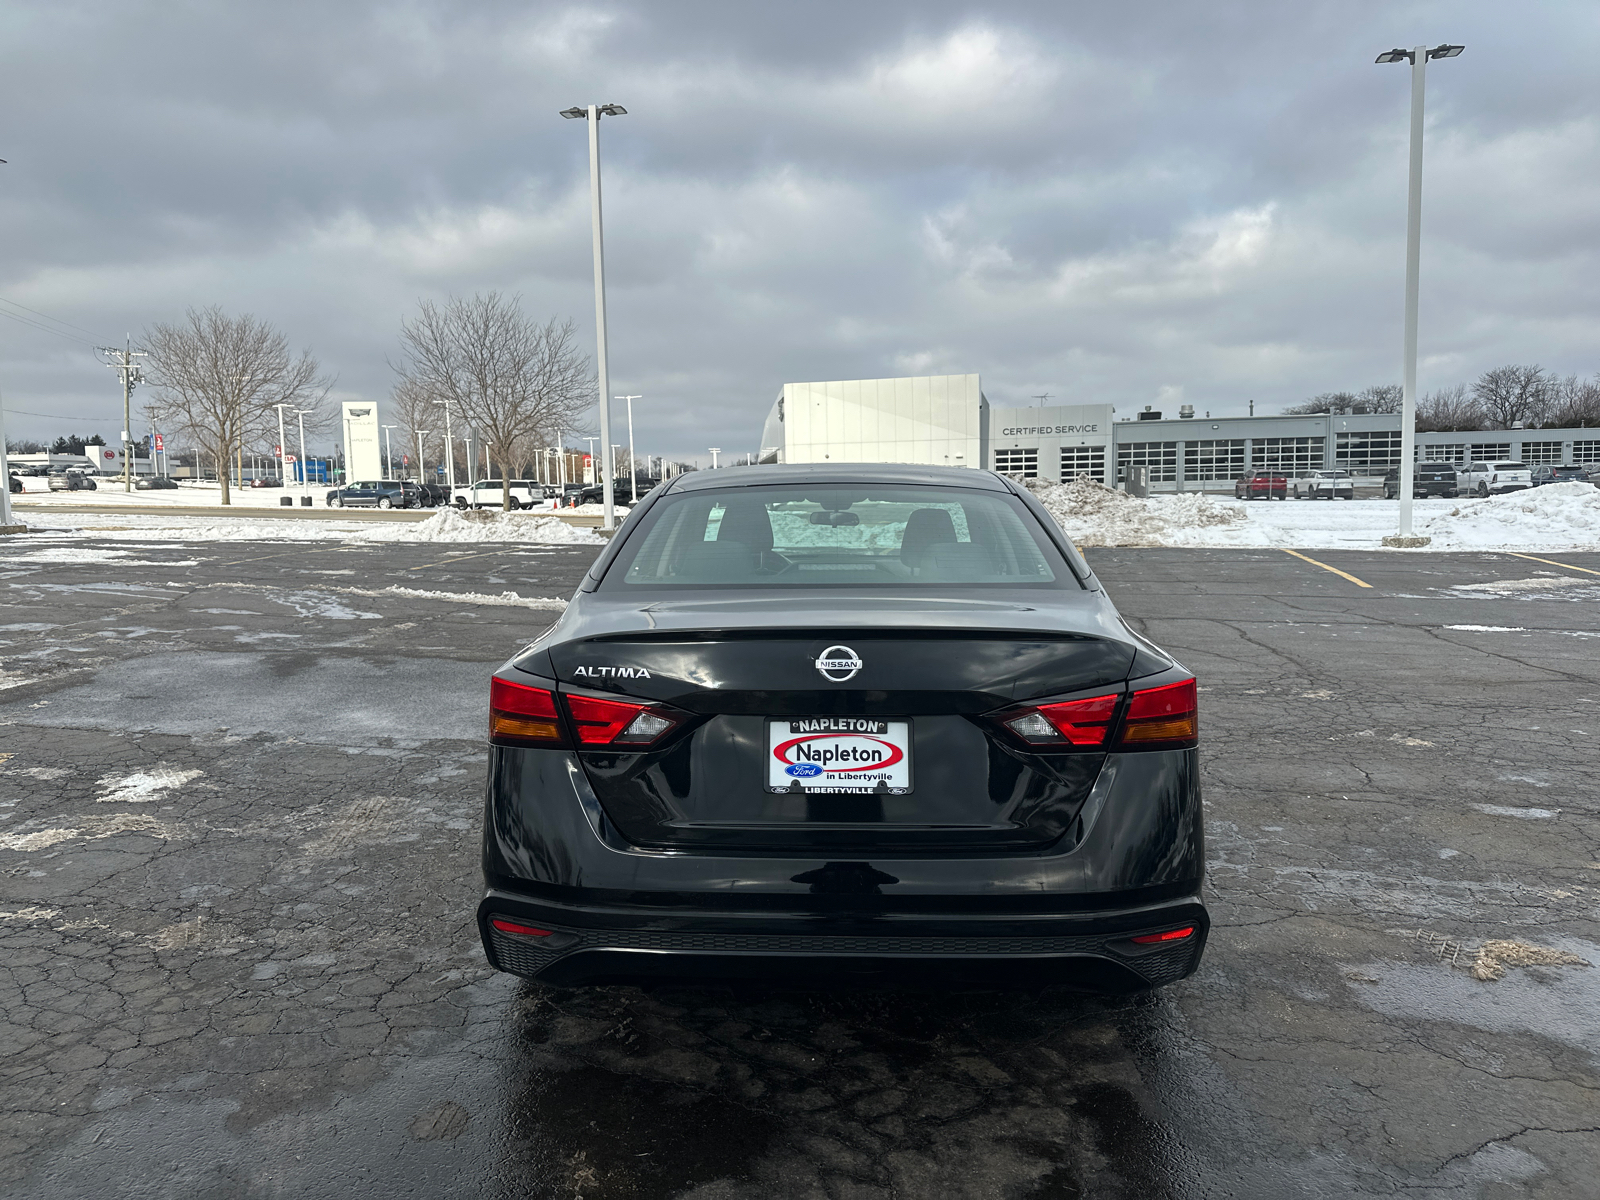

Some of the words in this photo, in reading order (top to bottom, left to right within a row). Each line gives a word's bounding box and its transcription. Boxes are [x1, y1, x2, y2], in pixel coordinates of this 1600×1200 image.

[1002, 426, 1053, 436] CERTIFIED
[1054, 424, 1098, 434] SERVICE
[573, 666, 651, 679] ALTIMA
[798, 718, 879, 733] NAPLETON
[796, 743, 882, 766] Napleton
[838, 772, 893, 782] Libertyville
